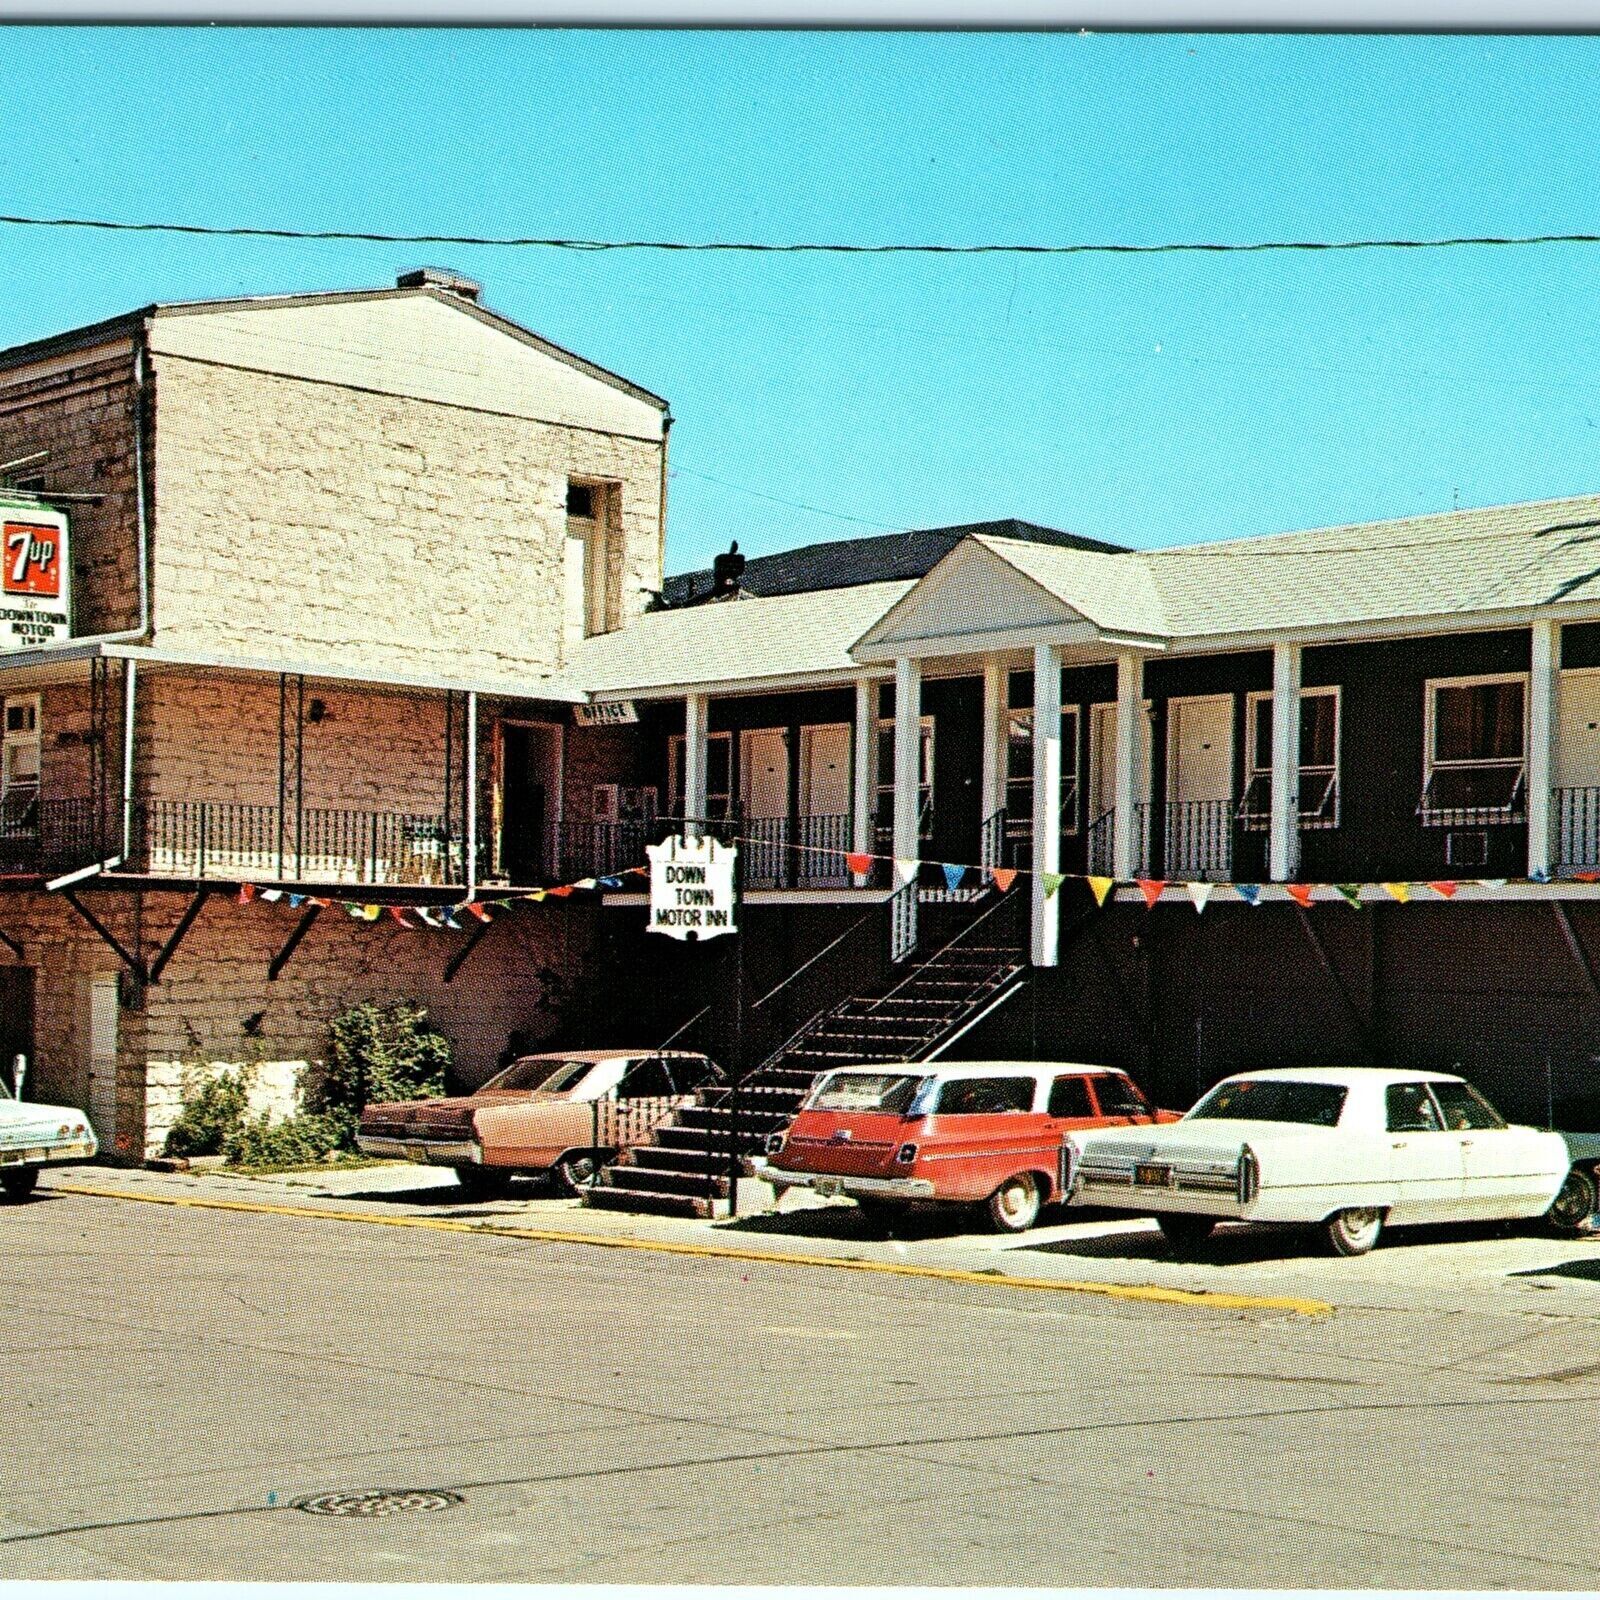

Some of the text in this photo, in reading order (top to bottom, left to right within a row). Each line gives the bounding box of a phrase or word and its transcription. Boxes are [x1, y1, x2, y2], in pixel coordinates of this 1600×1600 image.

[12, 623, 55, 637] MOTOR
[581, 702, 627, 719] OFFICE
[666, 866, 705, 883] DOWN
[675, 888, 714, 906] TOWN
[656, 908, 727, 926] MOTOR INN
